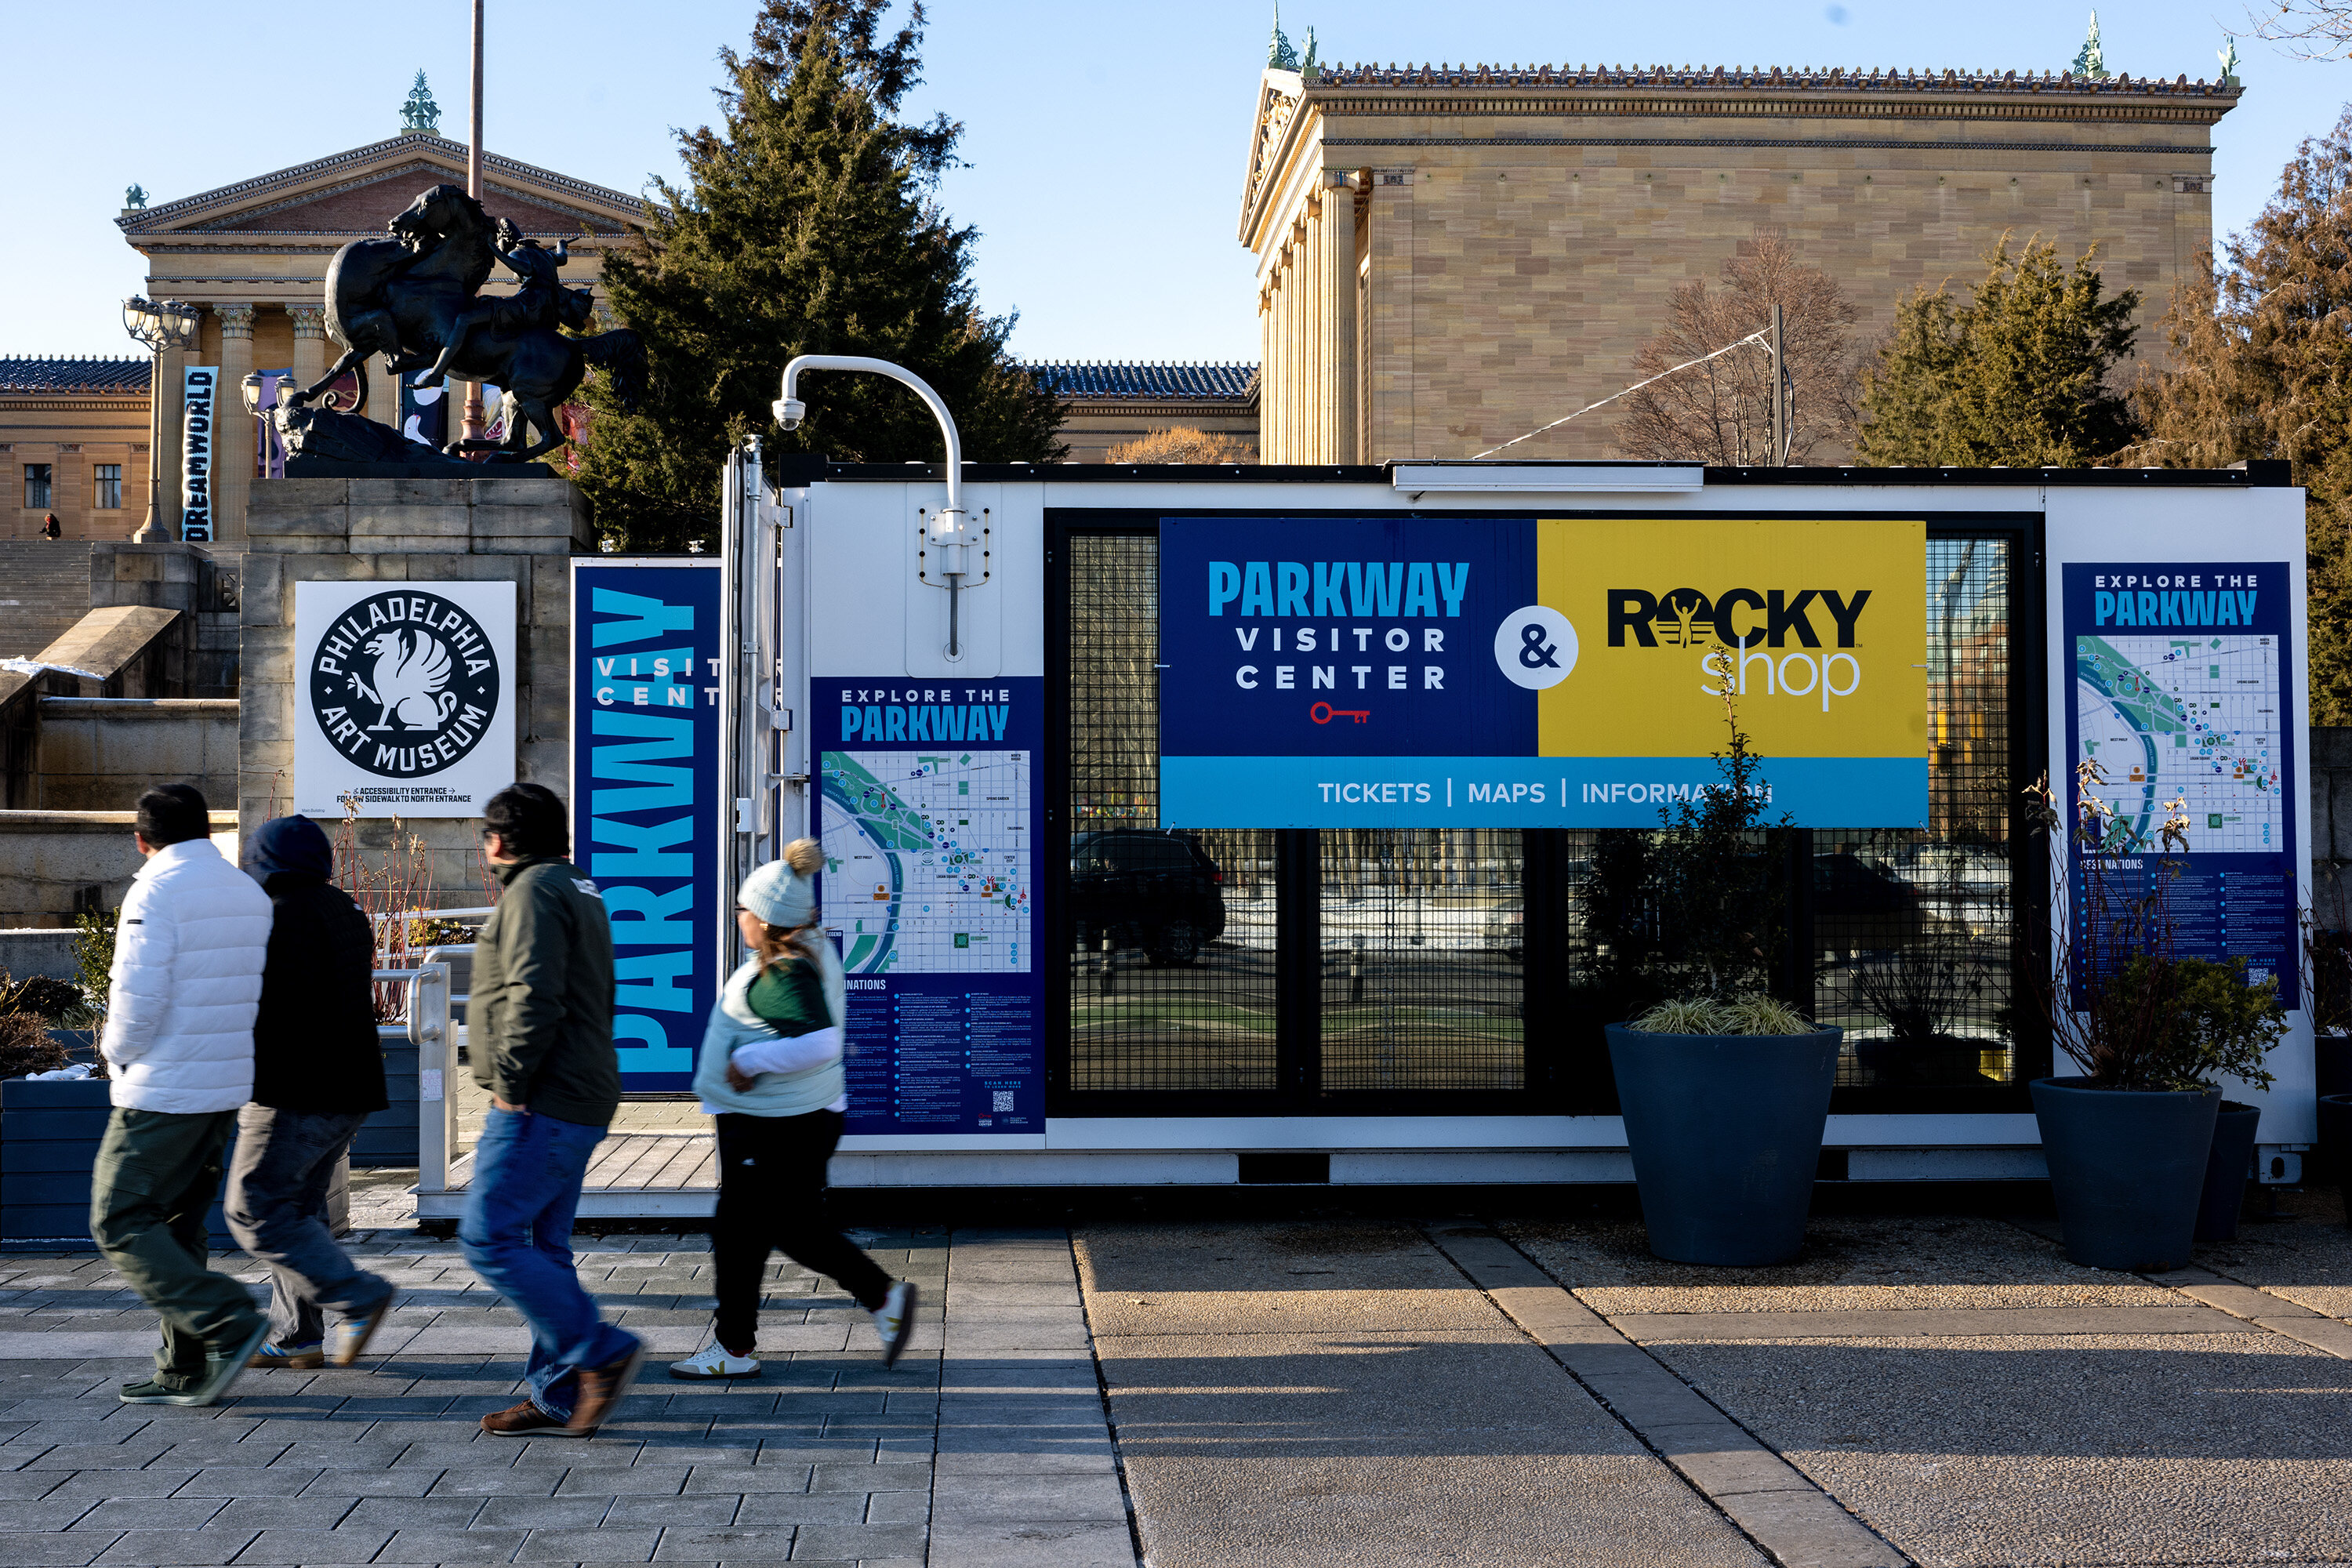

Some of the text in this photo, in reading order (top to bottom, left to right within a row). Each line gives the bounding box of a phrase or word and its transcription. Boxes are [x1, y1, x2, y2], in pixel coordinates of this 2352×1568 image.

[185, 372, 212, 542] DREAMWORLD
[1209, 561, 1470, 617] PARKWAY
[2095, 575, 2257, 587] EXPLORE THE
[1607, 588, 1872, 648] ROCKY
[2095, 590, 2258, 626] PARKWAY
[318, 597, 491, 677] PHILADELPHIA
[1236, 627, 1444, 652] VISITOR
[1519, 624, 1561, 669] &
[1236, 665, 1444, 690] CENTER
[1700, 636, 1860, 712] shop
[842, 689, 1009, 702] EXPLORE THE
[321, 702, 488, 771] ART MUSEUM
[841, 705, 1010, 742] PARKWAY
[1318, 782, 1772, 804] TICKETS MAPS INFORMAN
[592, 587, 694, 1073] PARKWAY
[2080, 859, 2143, 869] ESTNATIONS
[844, 979, 886, 990] INATIONS
